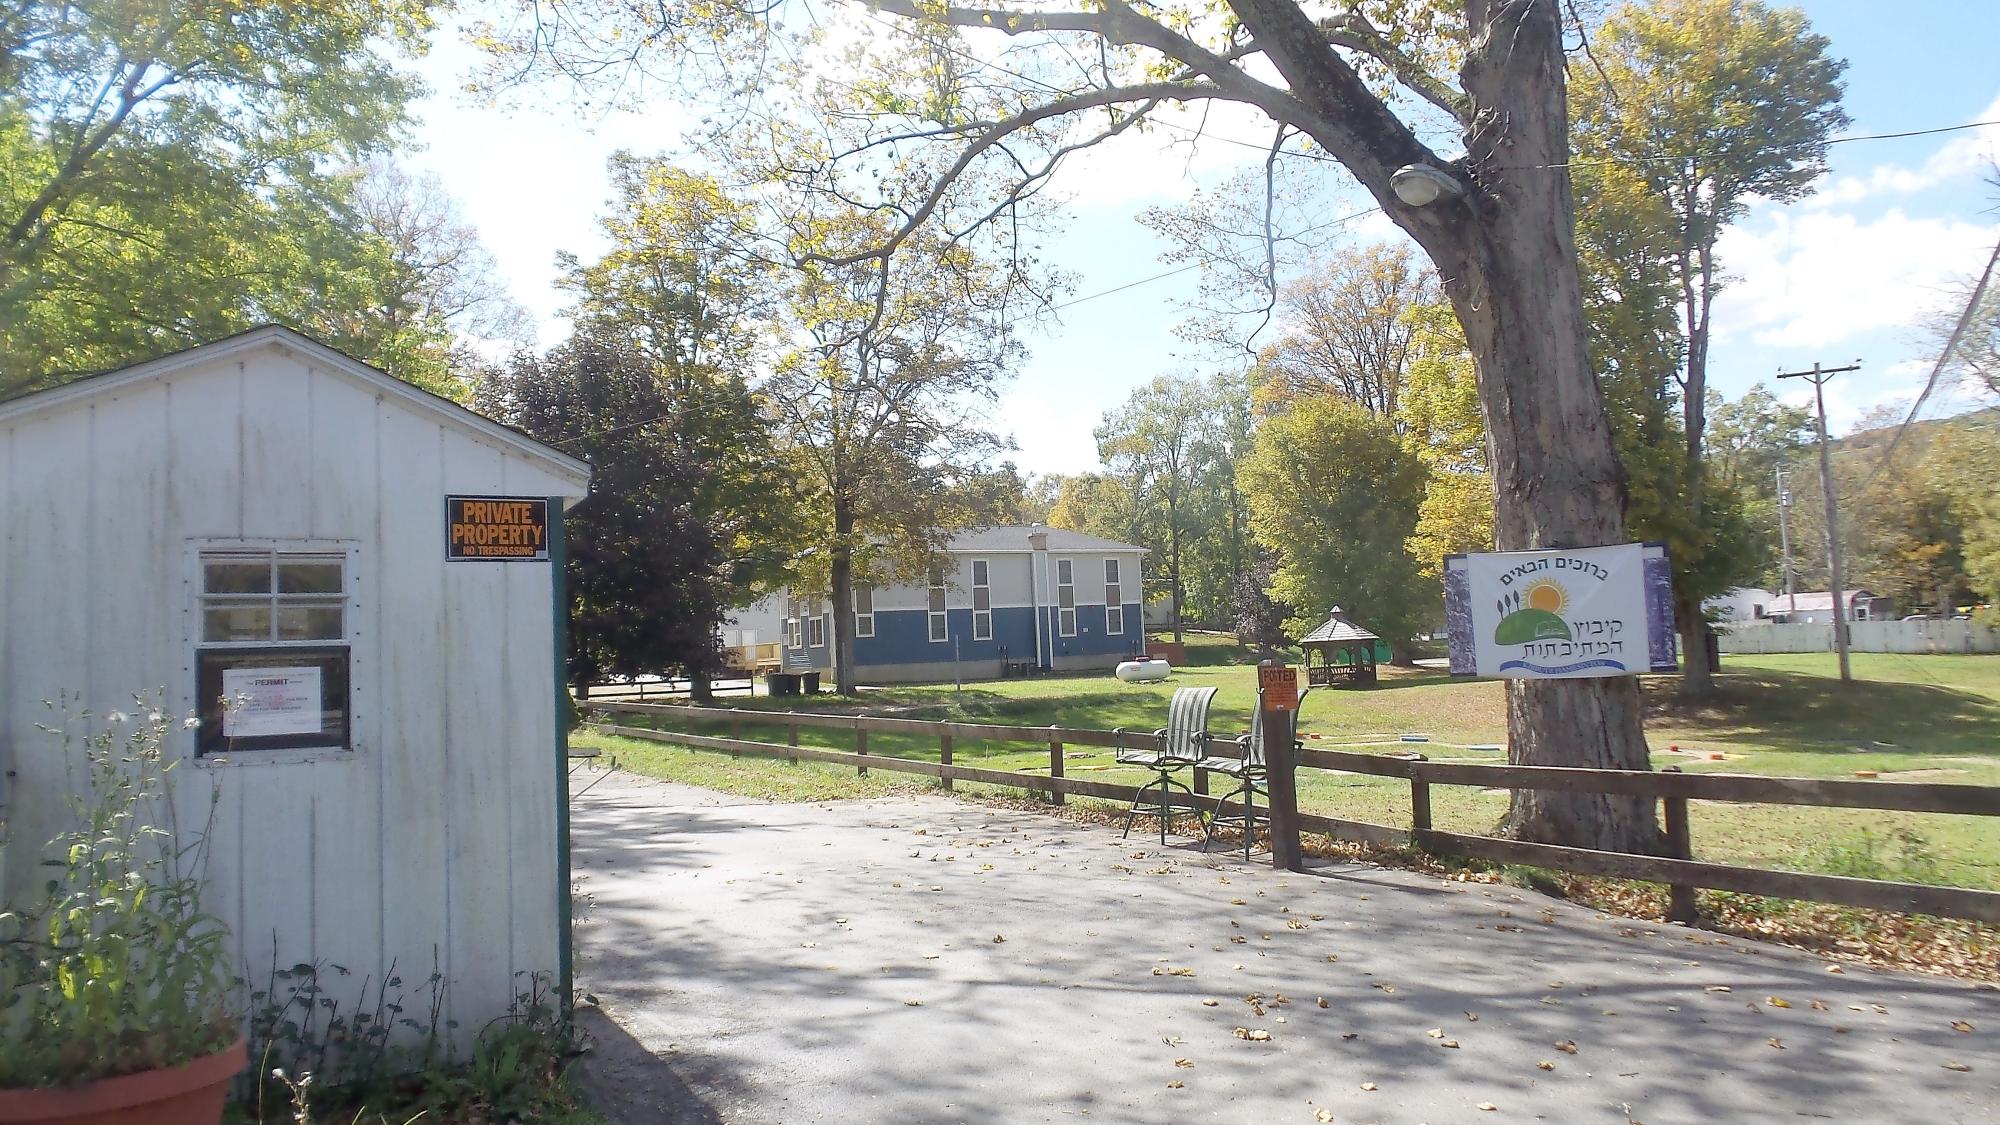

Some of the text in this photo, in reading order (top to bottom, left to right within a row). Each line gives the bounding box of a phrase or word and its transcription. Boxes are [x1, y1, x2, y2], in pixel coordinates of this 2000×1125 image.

[463, 501, 533, 524] PRIVATE
[452, 523, 543, 545] PROPERTY
[463, 546, 534, 556] NO TRESPASSING
[1500, 557, 1549, 586] הבאים
[1573, 619, 1623, 640] קיבוץ
[1522, 640, 1623, 660] המתיבתות
[254, 678, 289, 686] PERMIT
